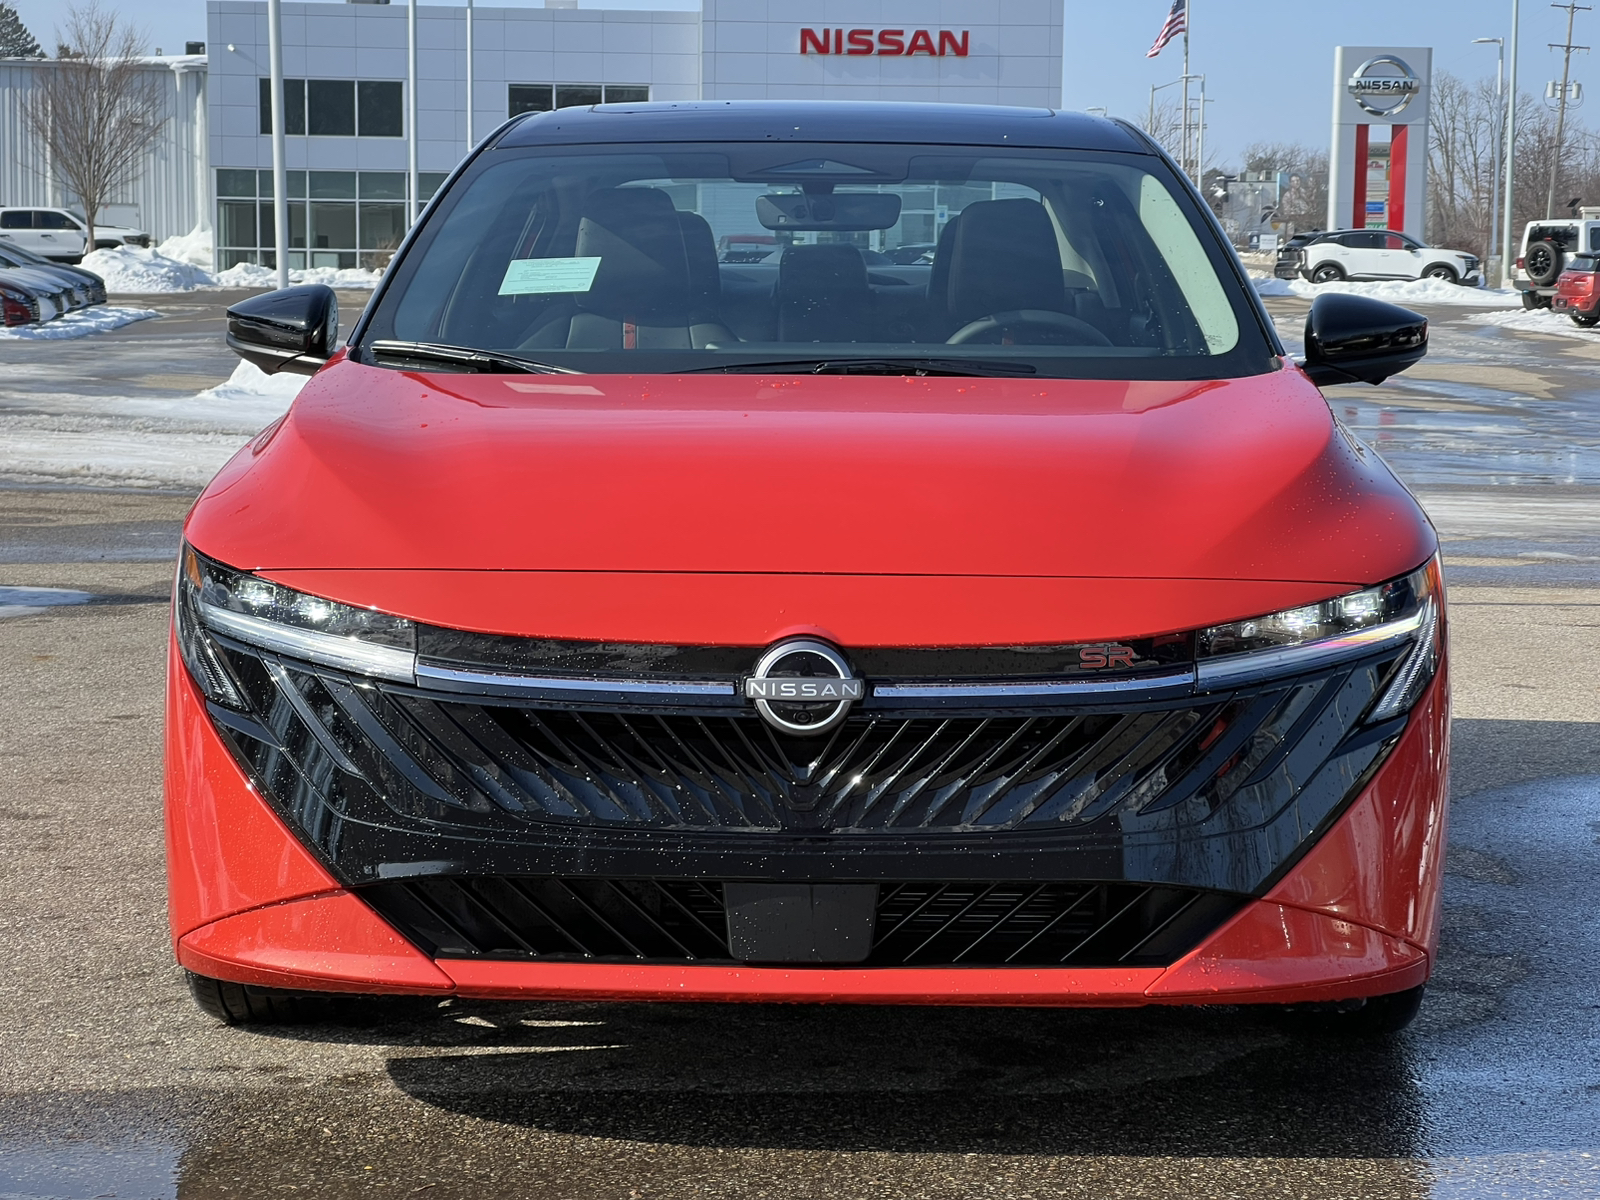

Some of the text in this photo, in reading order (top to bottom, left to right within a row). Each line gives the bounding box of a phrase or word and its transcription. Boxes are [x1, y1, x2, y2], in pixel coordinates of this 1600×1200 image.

[800, 28, 969, 56] NISSAN
[1356, 80, 1413, 90] NISSAN
[1080, 647, 1135, 668] SR
[750, 683, 858, 696] NISSAN
